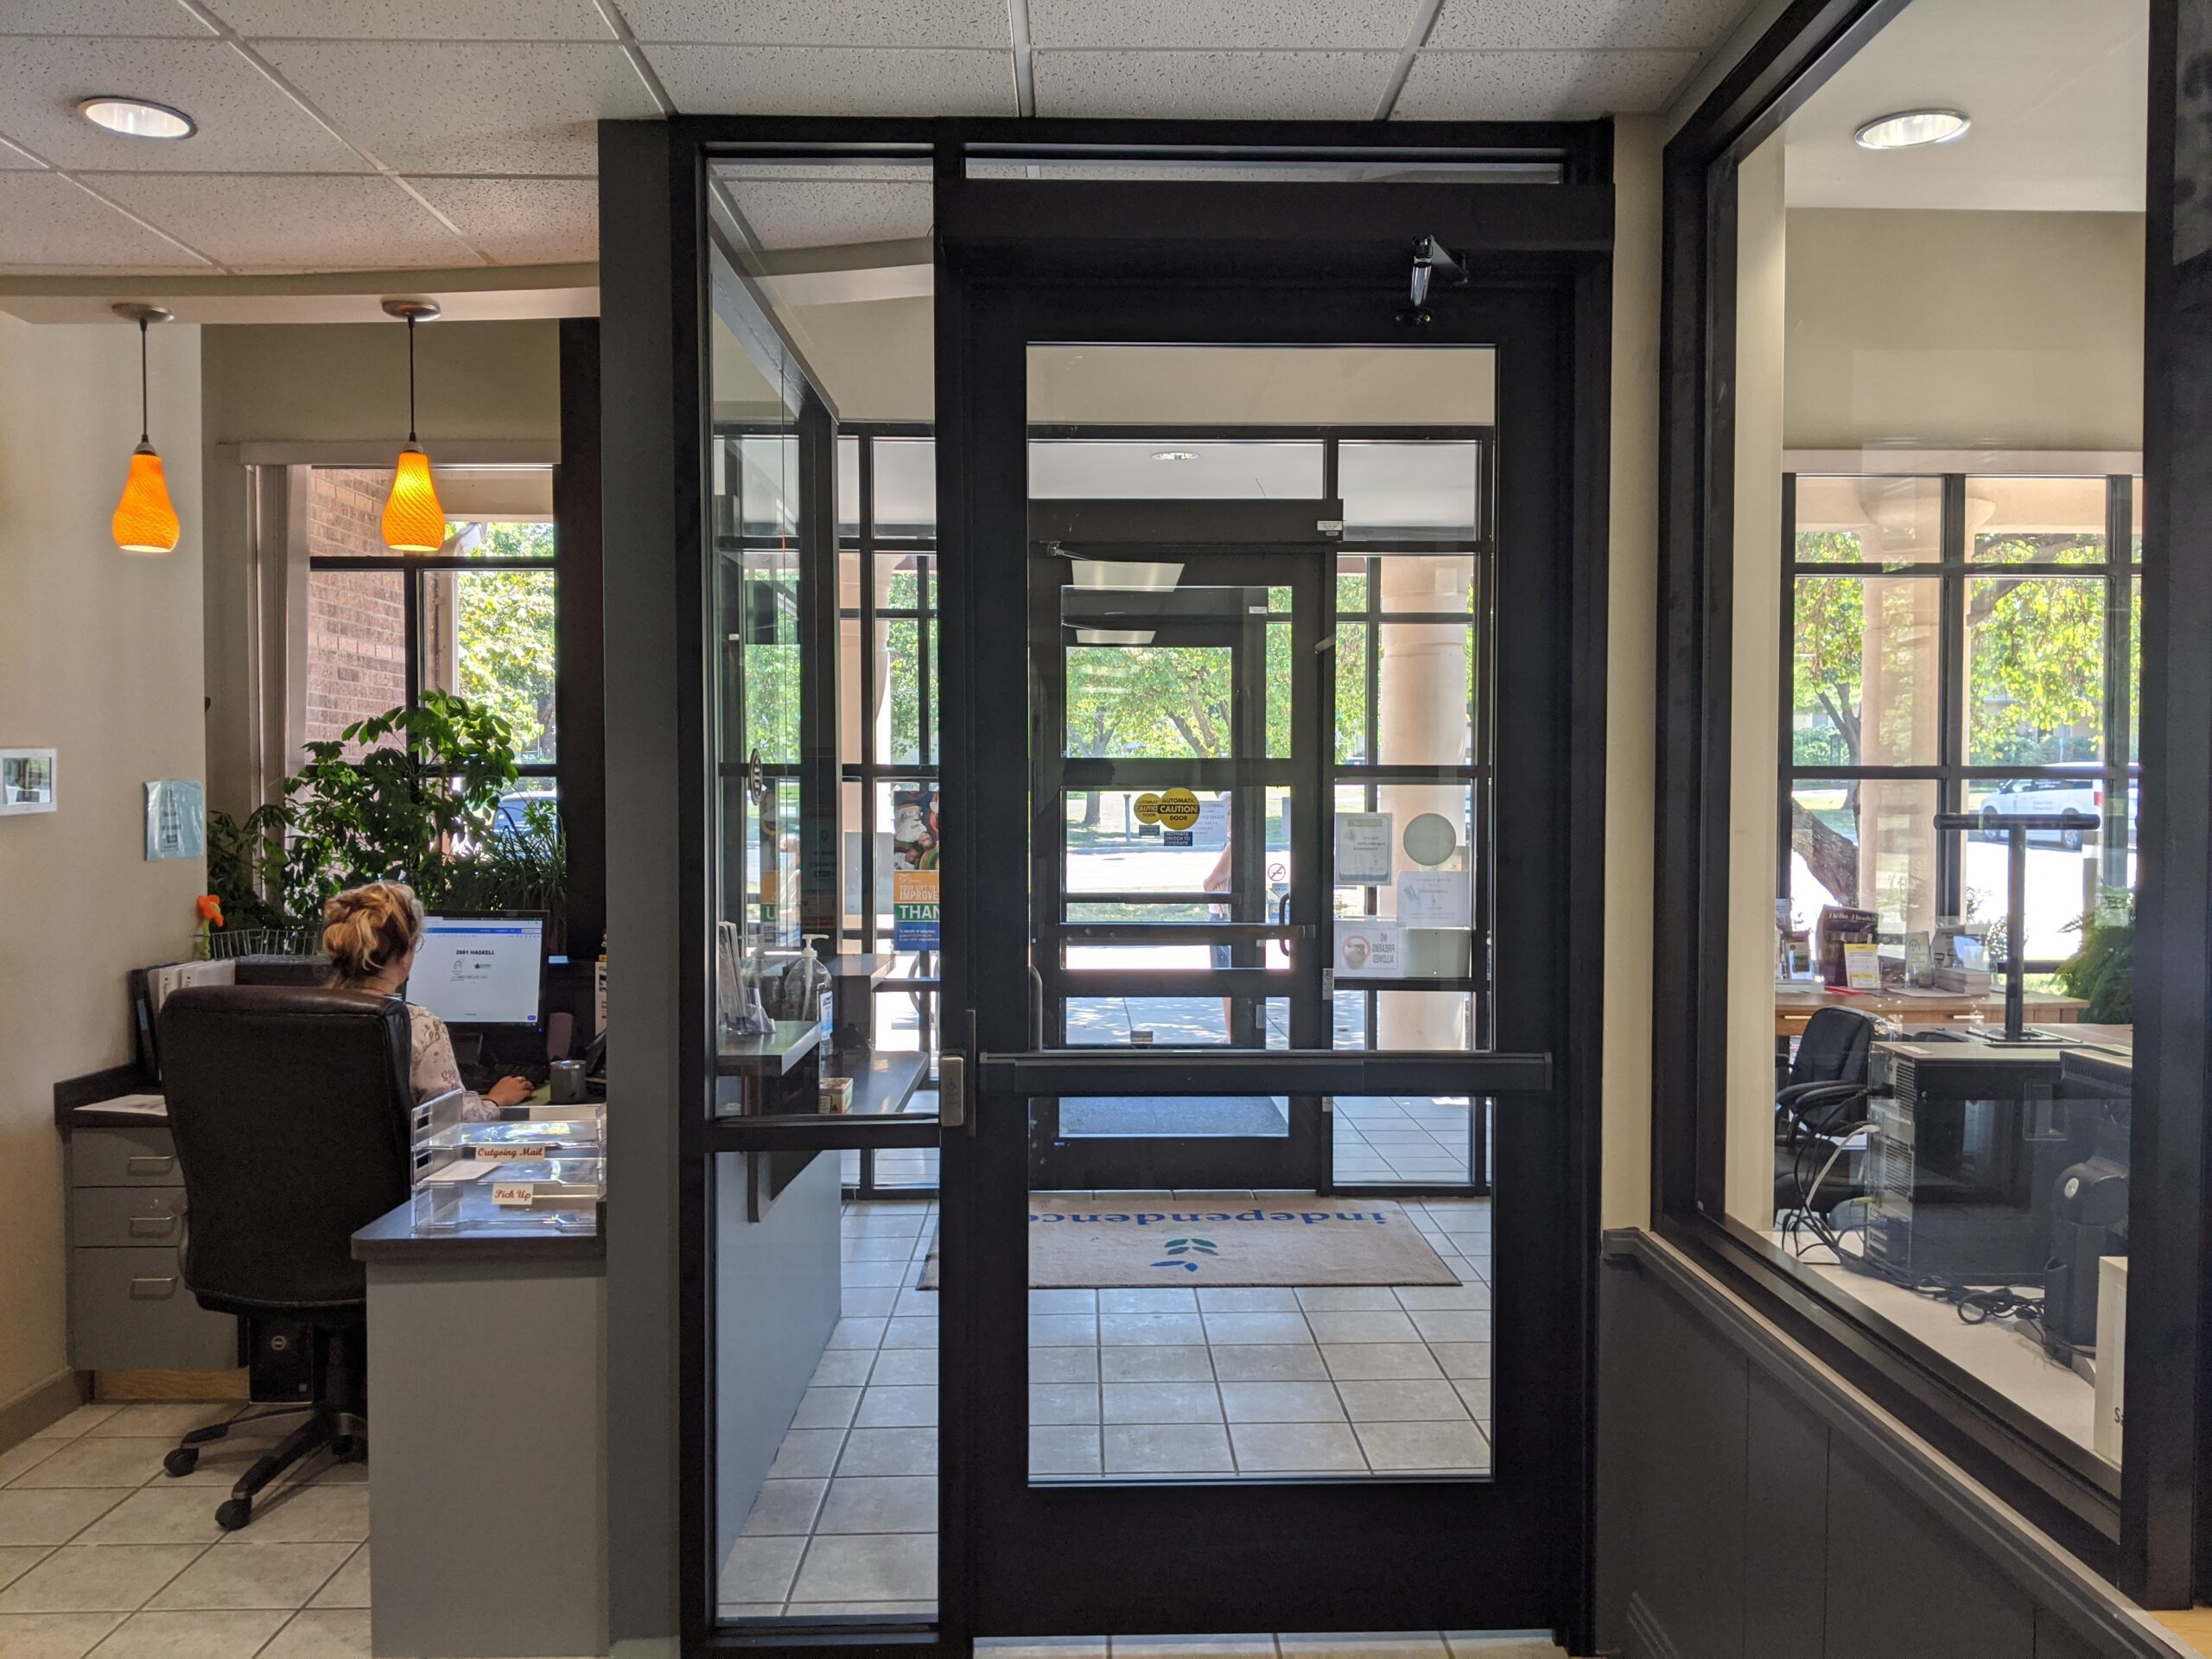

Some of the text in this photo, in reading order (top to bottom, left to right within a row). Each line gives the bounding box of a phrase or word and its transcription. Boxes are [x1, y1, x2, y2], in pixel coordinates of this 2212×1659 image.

[899, 891, 938, 900] IMPROVE
[477, 1147, 543, 1159] Outgoing Mail
[494, 1189, 531, 1200] Pick Up
